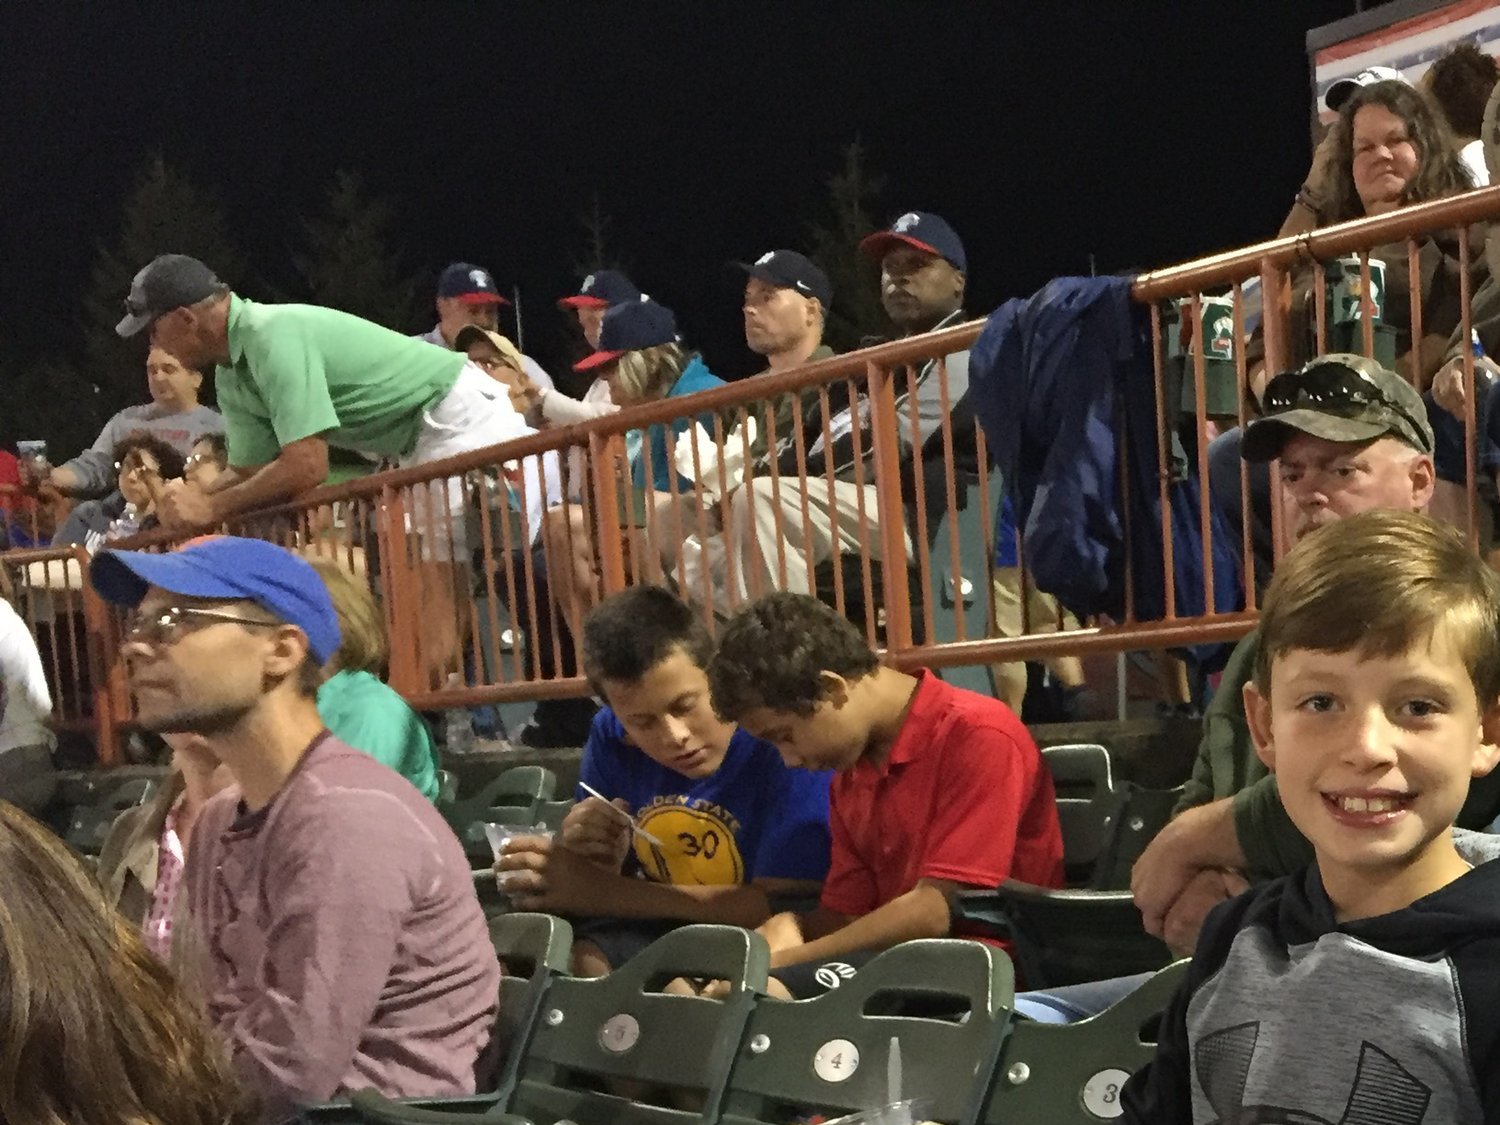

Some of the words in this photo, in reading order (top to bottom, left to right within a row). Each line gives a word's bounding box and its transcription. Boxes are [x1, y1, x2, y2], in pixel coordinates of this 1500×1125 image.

[678, 830, 720, 860] 30
[831, 1052, 842, 1069] 4
[1103, 1083, 1118, 1103] 3
